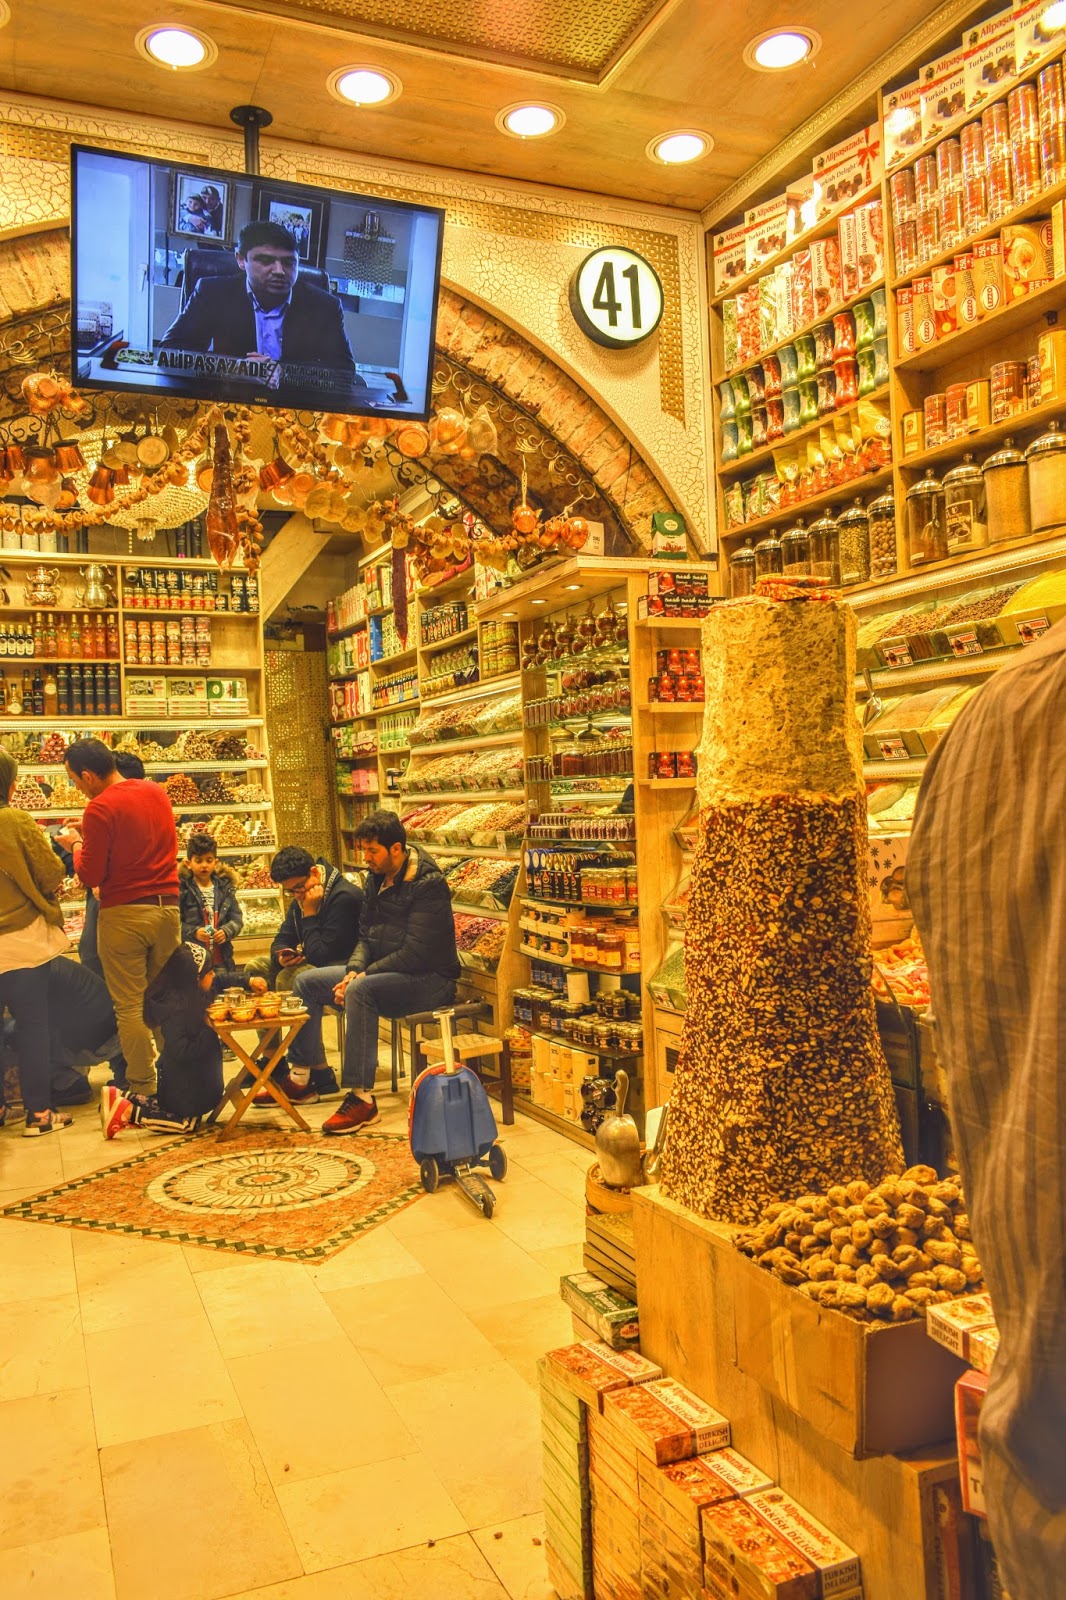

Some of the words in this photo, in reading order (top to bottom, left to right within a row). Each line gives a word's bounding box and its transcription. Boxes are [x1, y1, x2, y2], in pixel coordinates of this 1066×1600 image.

[968, 49, 994, 69] Turkish
[995, 39, 1015, 54] Delig
[924, 86, 948, 103] Turkish
[949, 77, 964, 90] Deli
[819, 174, 836, 187] urkish
[592, 261, 642, 329] 41
[986, 287, 994, 308] LEZZO
[930, 1315, 959, 1340] TURKISH
[930, 1326, 959, 1351] DELIGHT
[648, 1384, 674, 1406] TURKISH
[671, 1403, 700, 1425] DELIGHT
[699, 1427, 728, 1441] TURKISH
[699, 1435, 729, 1449] DELIGHT
[711, 1463, 744, 1487] DELIGHT
[753, 1499, 789, 1531] TURKISH
[787, 1530, 824, 1562] DELIGHT
[824, 1563, 858, 1581] TURKISH
[824, 1572, 857, 1590] DELIGHT
